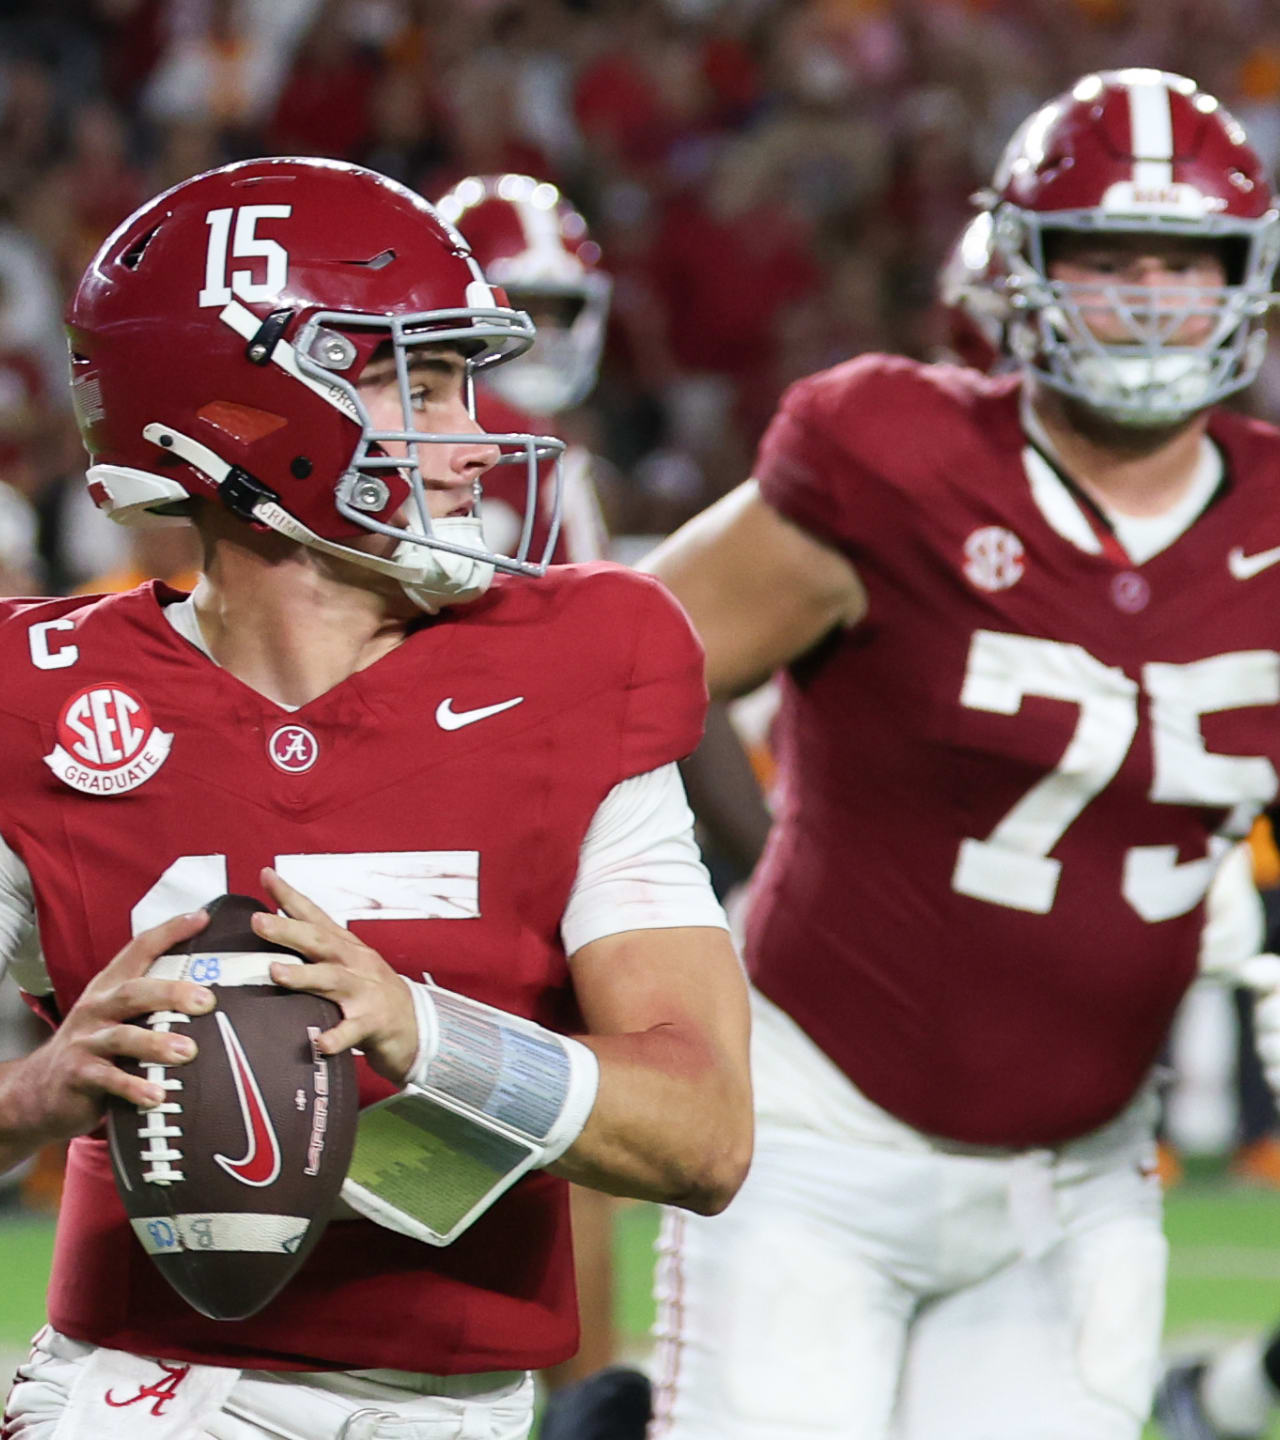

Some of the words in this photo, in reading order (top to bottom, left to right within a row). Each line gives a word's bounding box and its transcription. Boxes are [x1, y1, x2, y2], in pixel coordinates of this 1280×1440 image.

[199, 204, 292, 308] 15
[29, 619, 79, 670] C
[65, 689, 144, 765] SEC
[65, 752, 159, 791] GRADUATE
[105, 1359, 191, 1416] A
